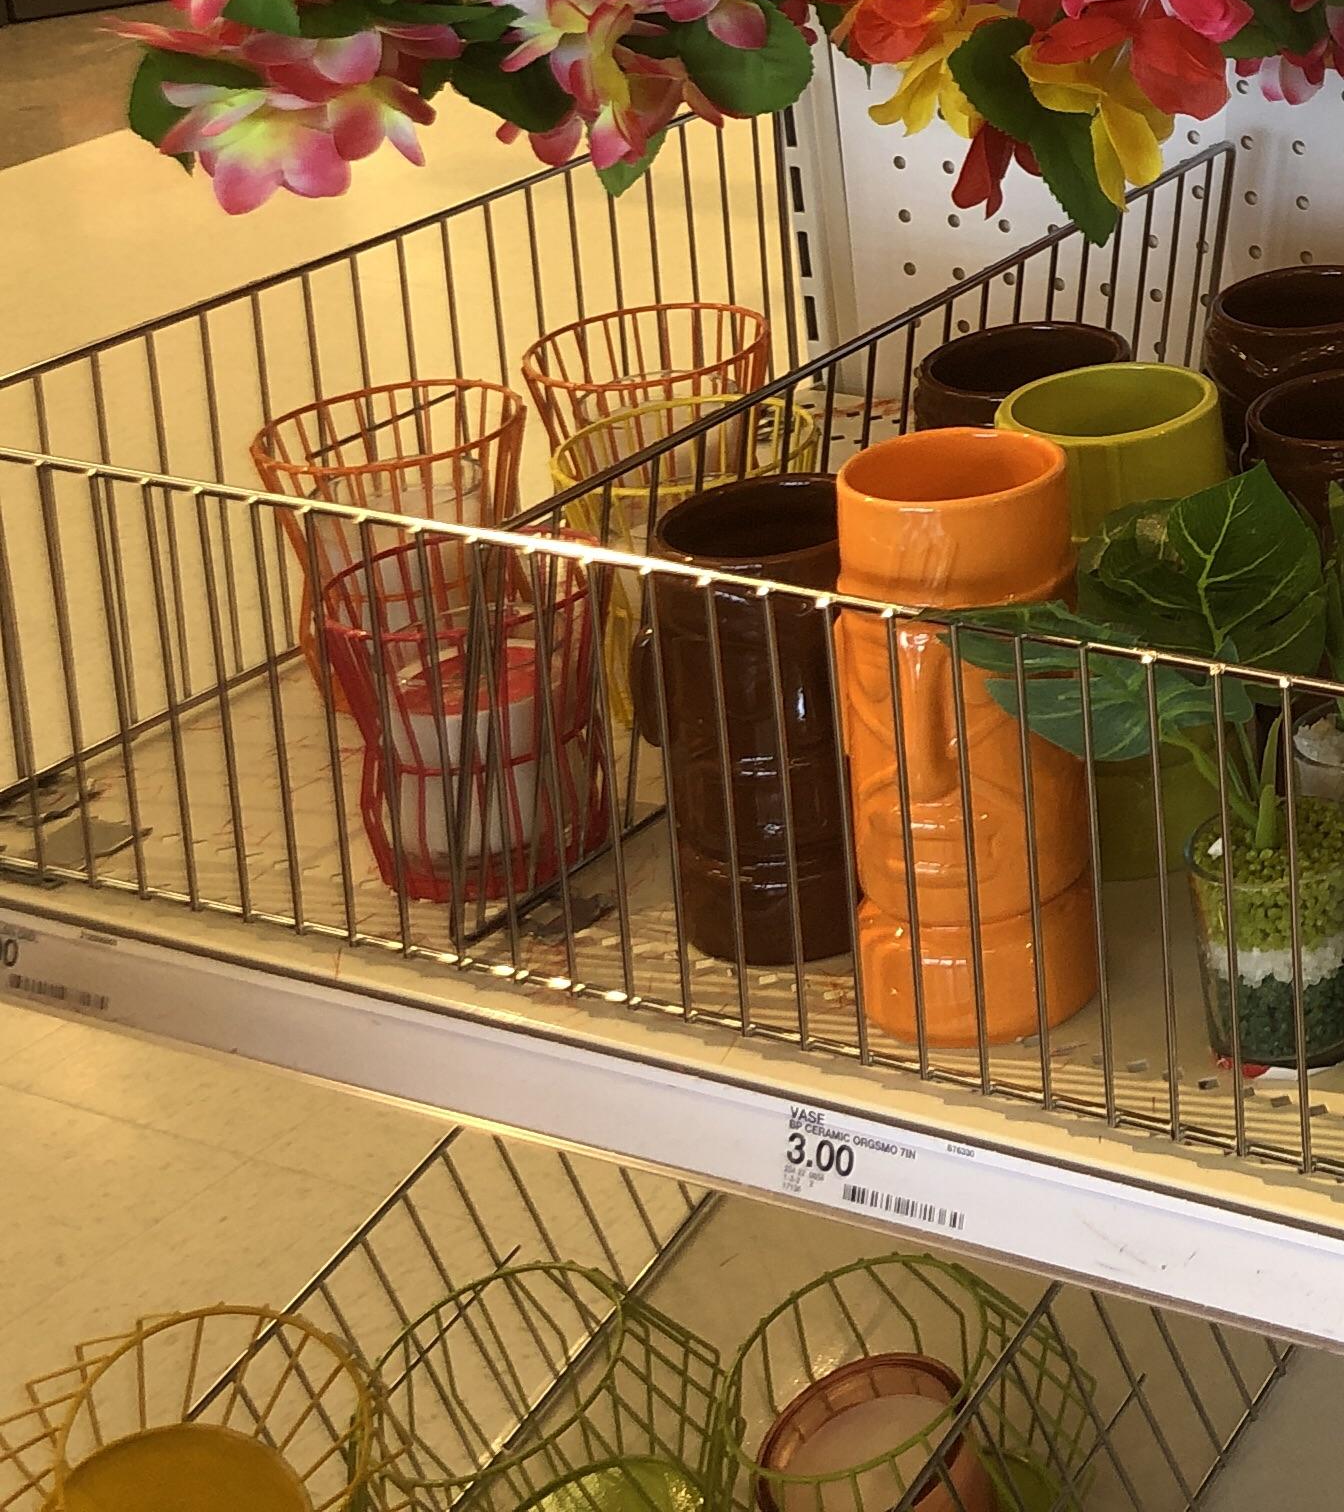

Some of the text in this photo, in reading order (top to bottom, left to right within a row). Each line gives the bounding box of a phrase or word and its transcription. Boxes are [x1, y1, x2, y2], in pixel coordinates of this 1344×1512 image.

[790, 1106, 826, 1126] VASE
[786, 1132, 854, 1177] 3.00
[789, 1119, 802, 1130] BP
[804, 1122, 851, 1144] CERAMIC
[899, 1147, 917, 1161] 7IN
